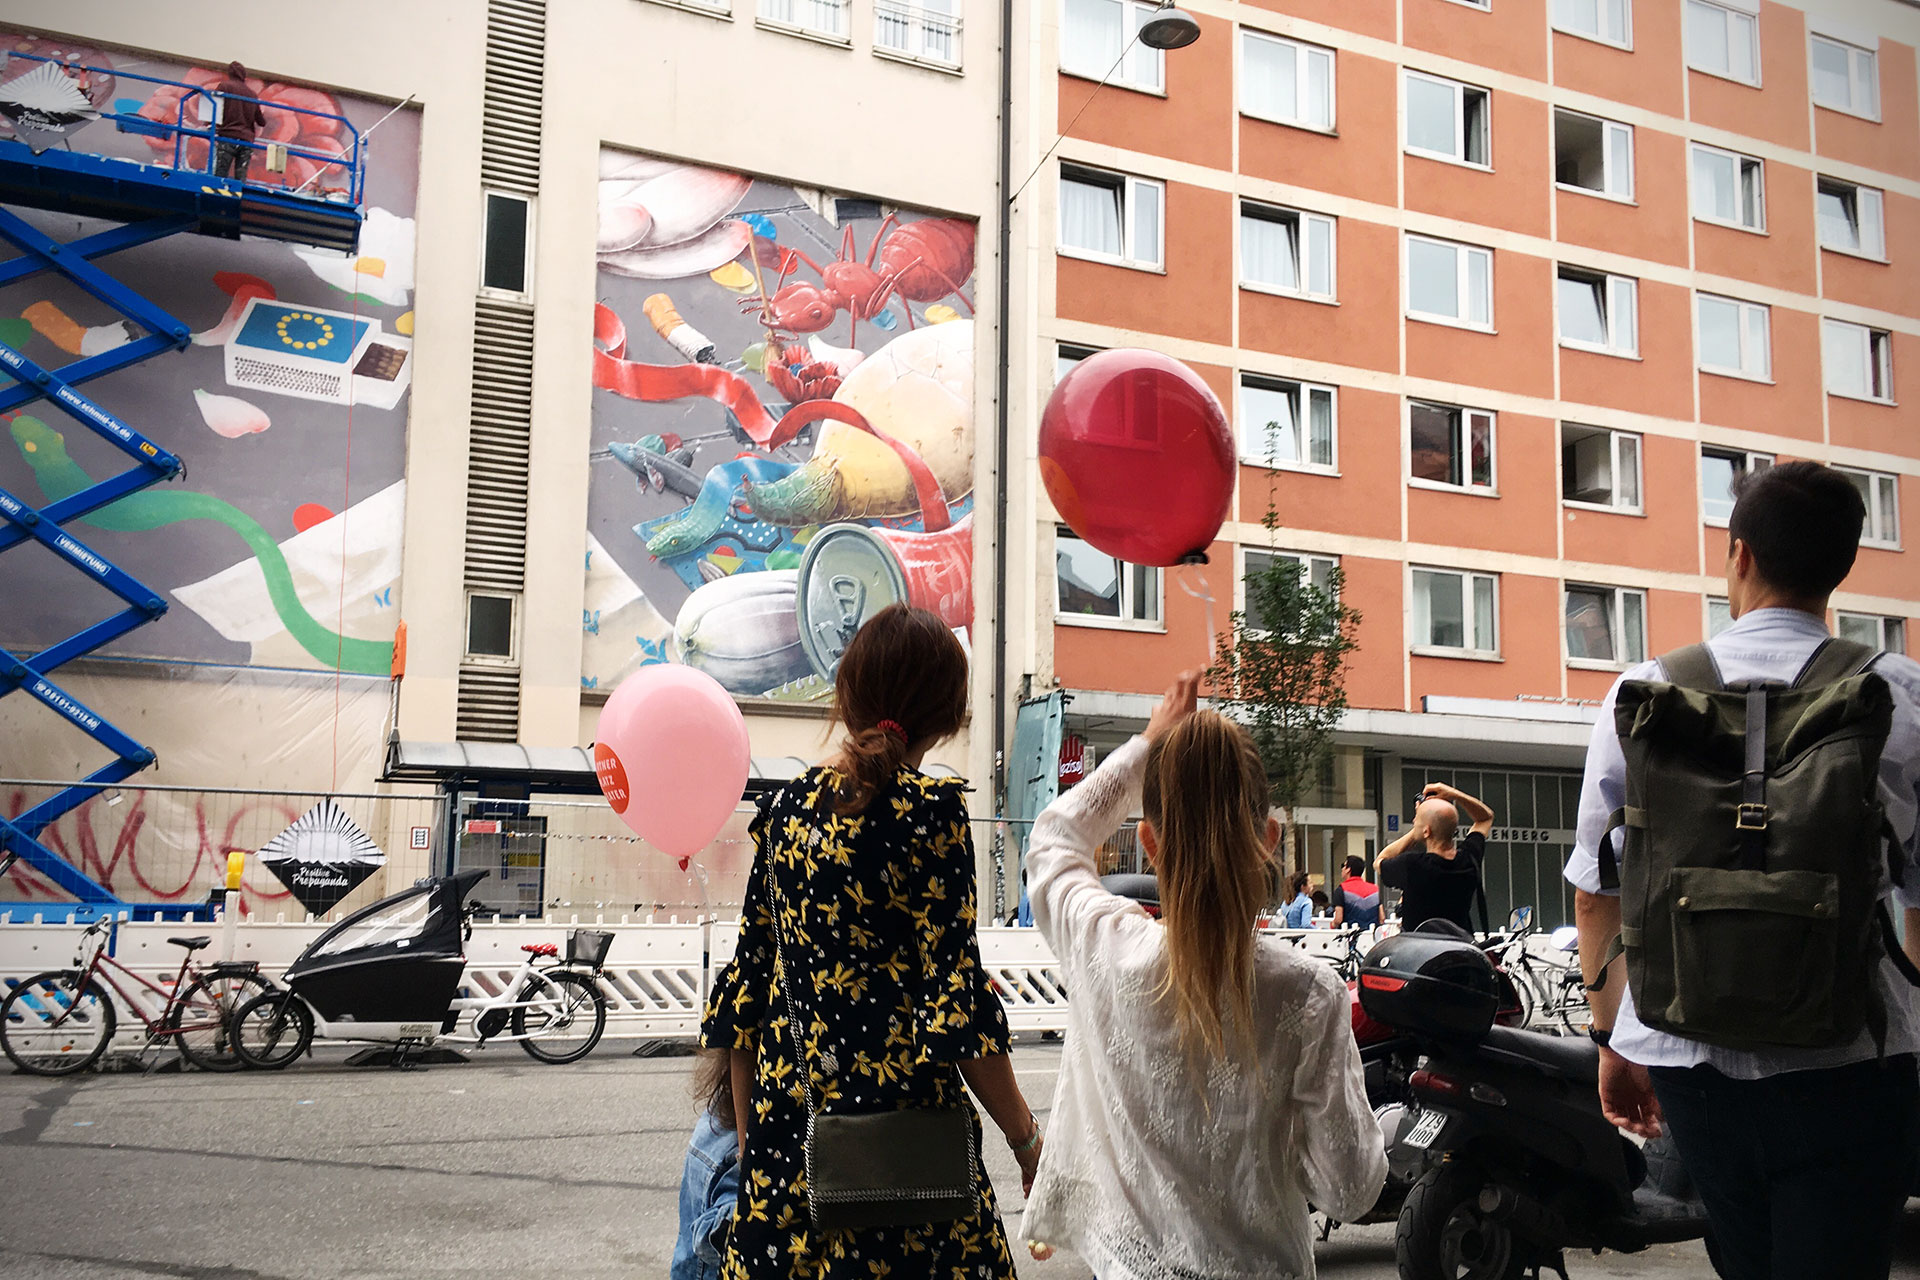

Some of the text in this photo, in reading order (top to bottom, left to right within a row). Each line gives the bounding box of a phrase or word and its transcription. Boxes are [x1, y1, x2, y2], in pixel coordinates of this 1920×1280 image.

[60, 537, 107, 574] VERMIETUNG
[300, 866, 331, 877] Positive
[292, 874, 349, 888] Propaganda
[1419, 1110, 1446, 1130] 729
